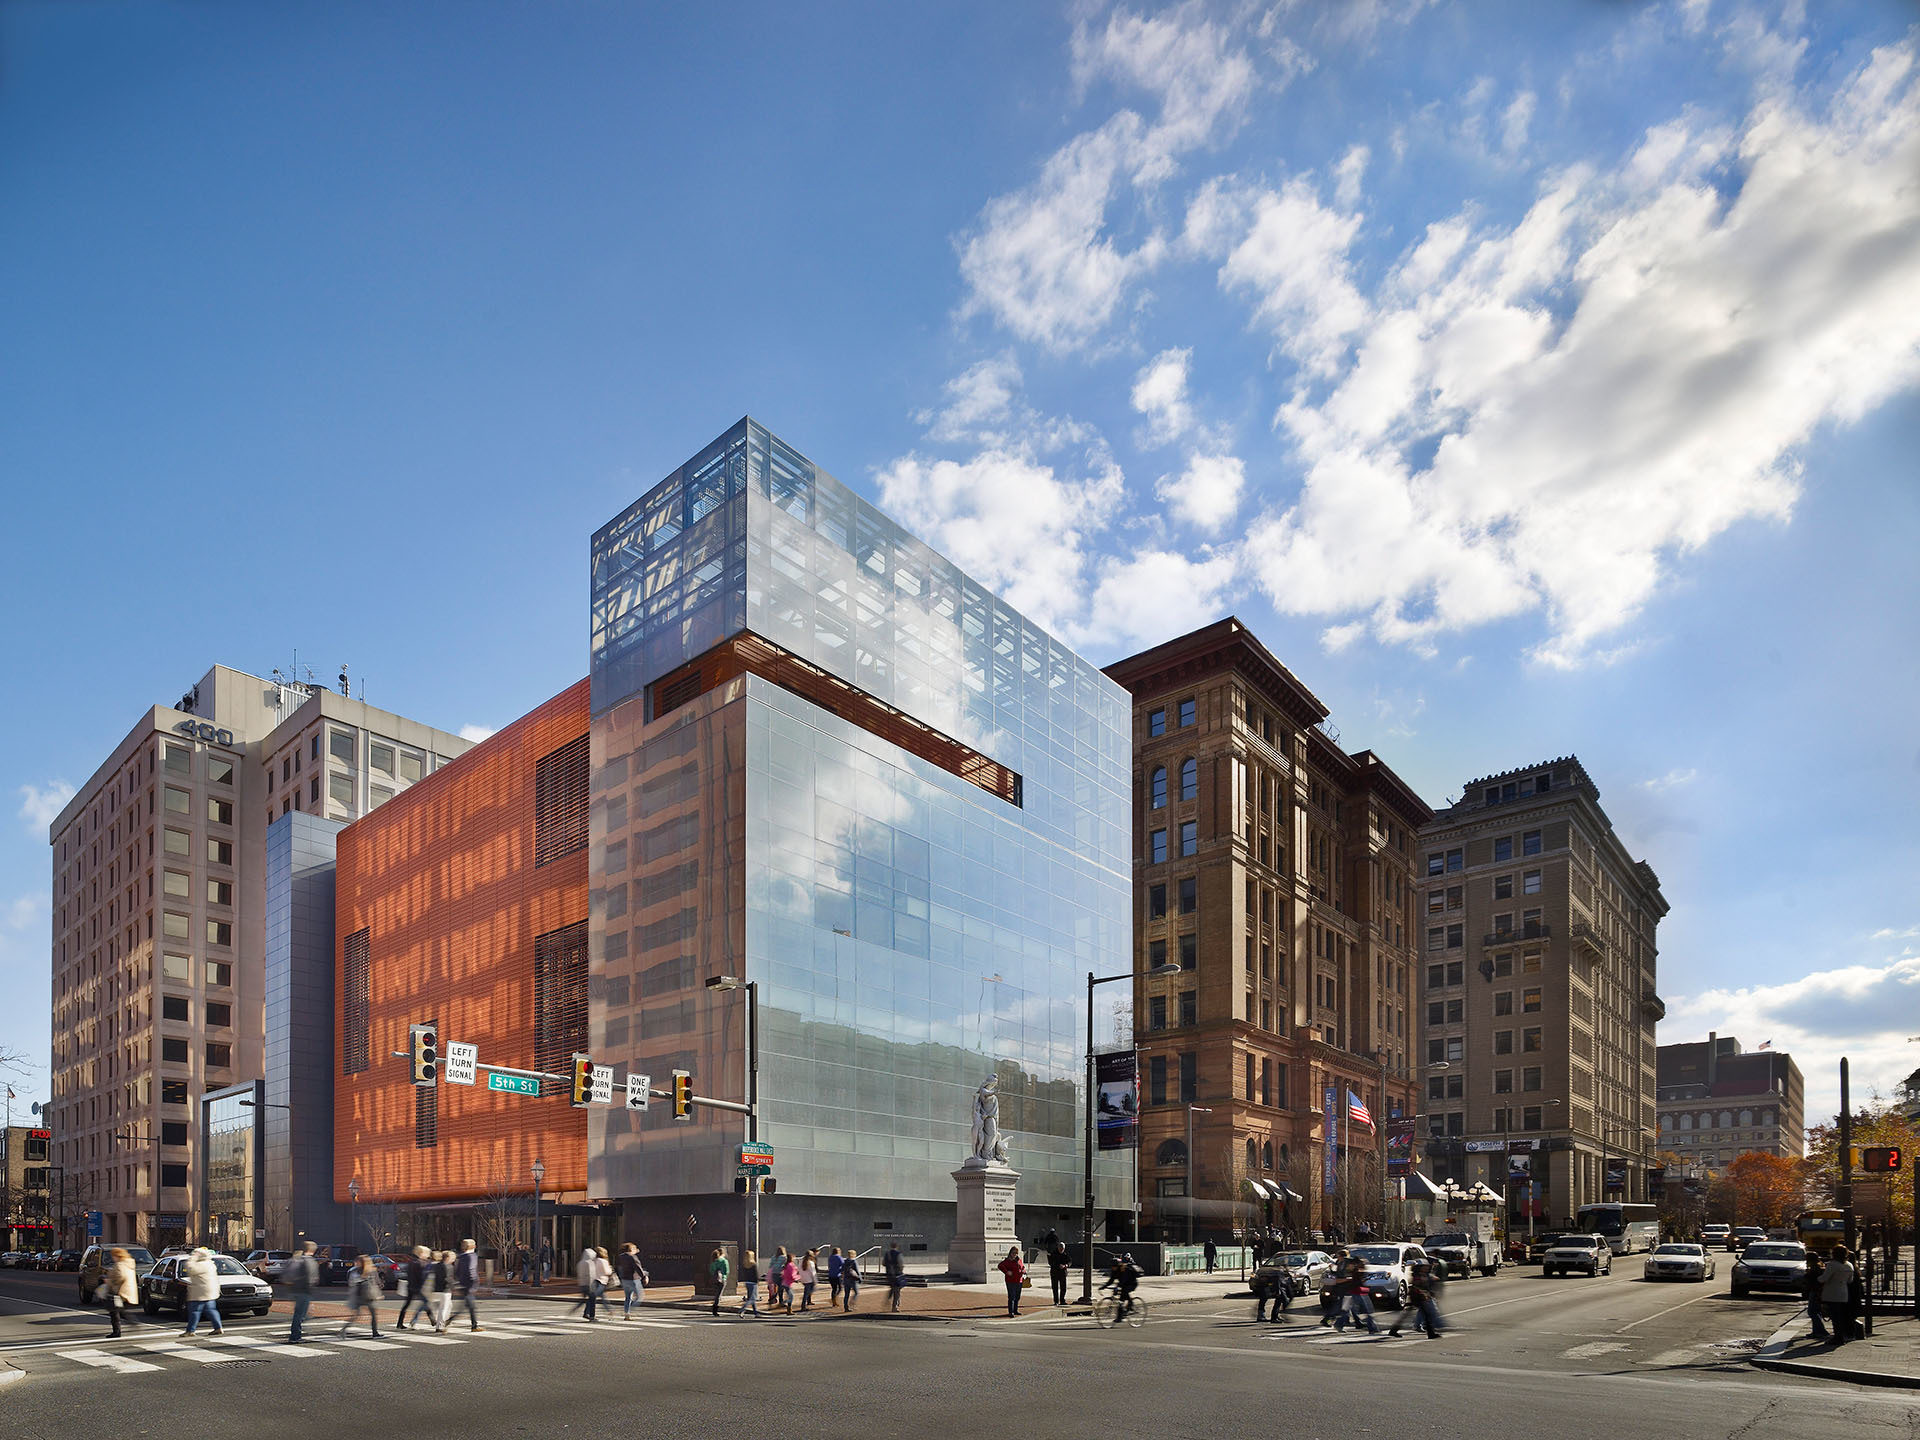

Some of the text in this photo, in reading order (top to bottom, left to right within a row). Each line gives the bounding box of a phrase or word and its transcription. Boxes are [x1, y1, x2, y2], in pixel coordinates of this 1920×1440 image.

[181, 719, 233, 746] 400
[452, 1047, 472, 1057] LEFT
[450, 1058, 472, 1068] TURN
[448, 1069, 472, 1080] SIGNAL
[592, 1070, 609, 1079] LEFT
[495, 1076, 533, 1092] 5th St
[631, 1076, 646, 1087] ONE
[630, 1086, 646, 1096] WAY
[32, 1129, 51, 1139] FOX
[1889, 1151, 1898, 1167] 2
